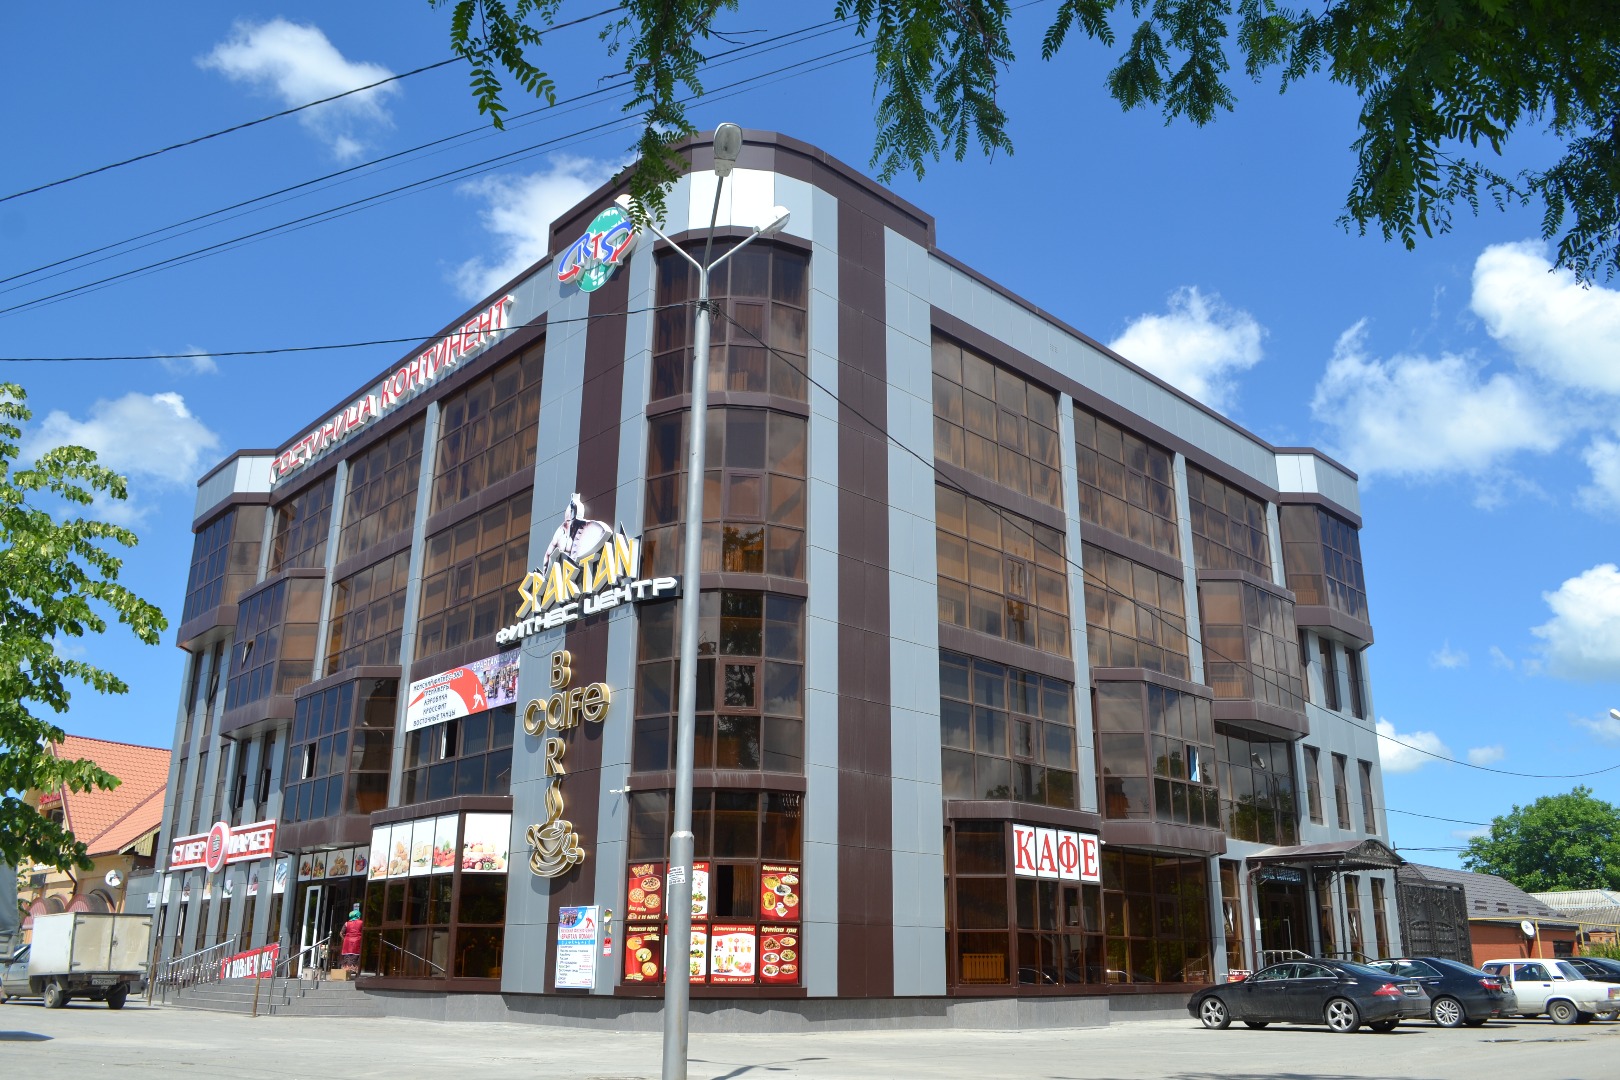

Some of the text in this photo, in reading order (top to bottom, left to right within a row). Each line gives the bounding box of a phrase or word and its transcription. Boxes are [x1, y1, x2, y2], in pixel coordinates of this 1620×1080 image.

[269, 294, 516, 484] ГОСТИНИЦА КОНТИНЕНТ
[516, 523, 641, 618] SPARTAN
[495, 576, 678, 645] ФИТНЕС ЦЕНТР
[171, 841, 207, 863] СУПЕР
[227, 829, 274, 855] МАРКЕТ
[1014, 829, 1098, 877] КАФЕ
